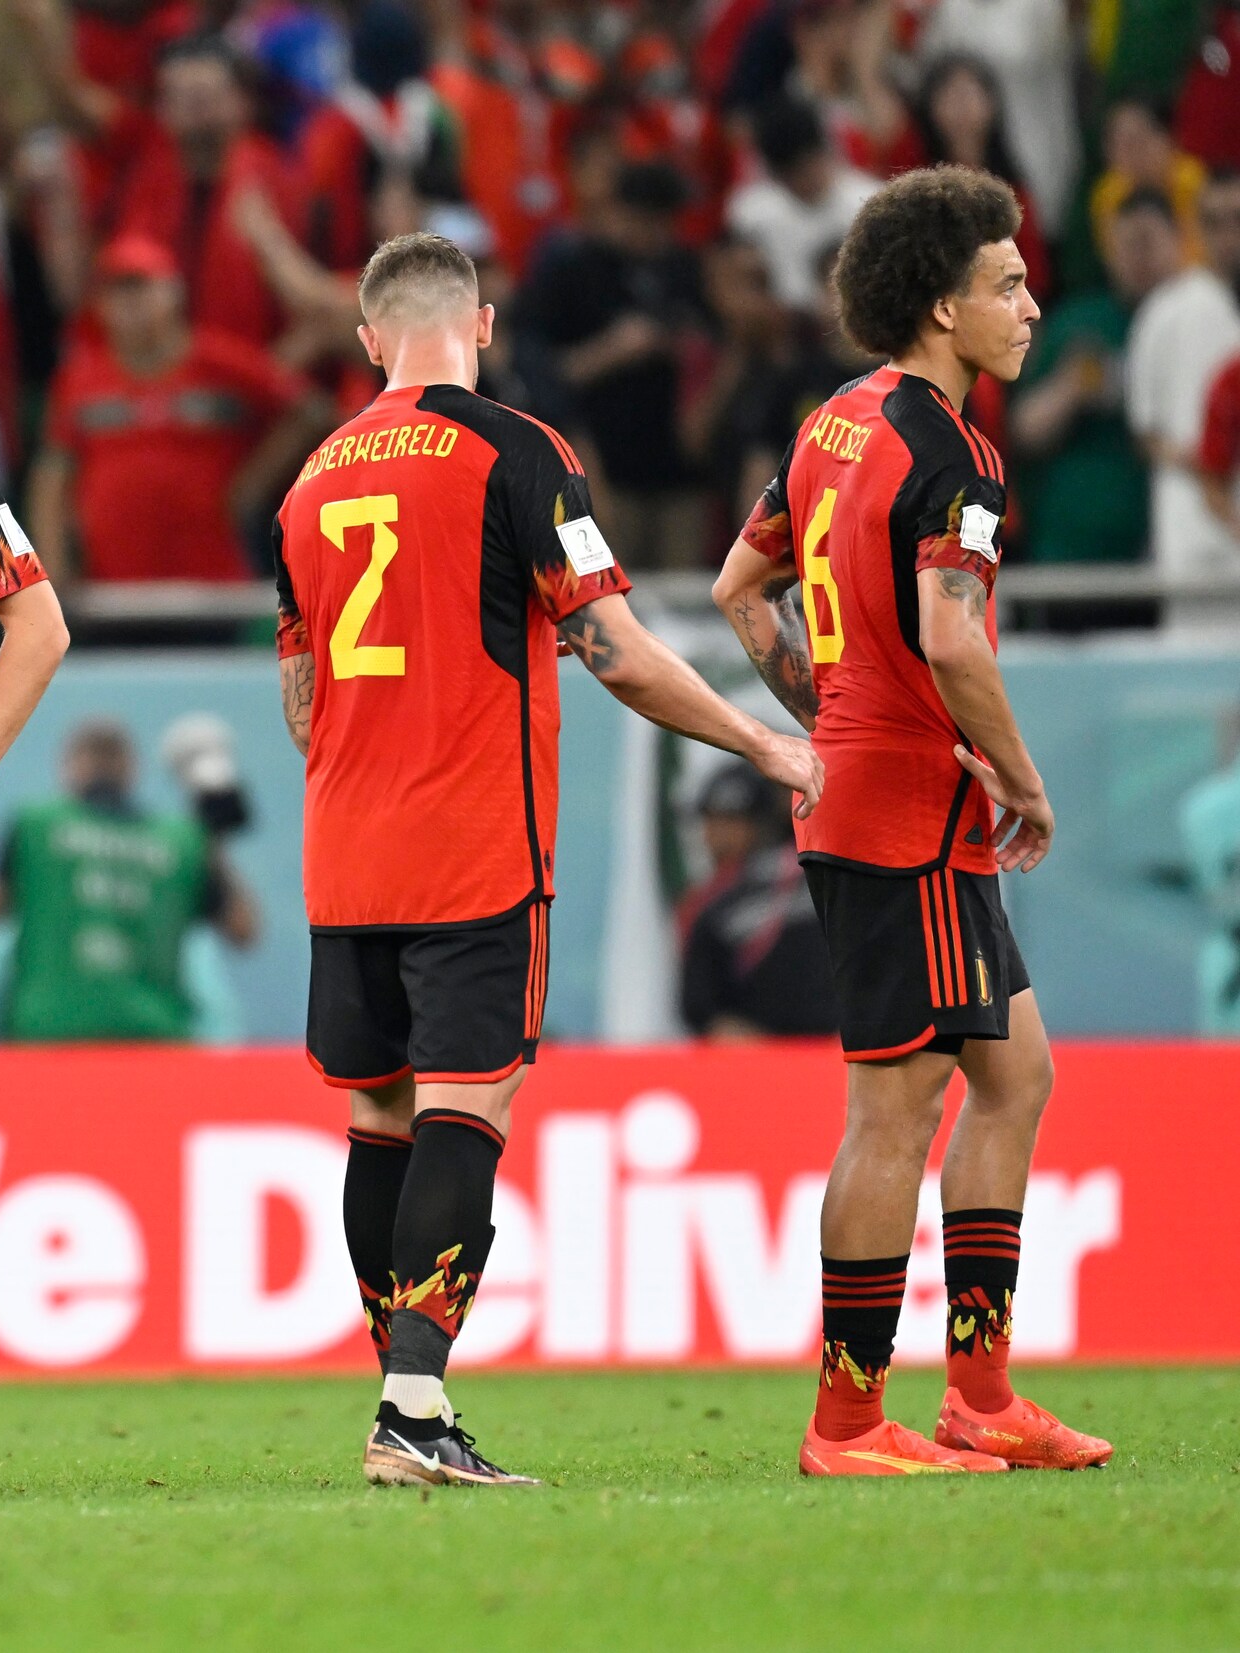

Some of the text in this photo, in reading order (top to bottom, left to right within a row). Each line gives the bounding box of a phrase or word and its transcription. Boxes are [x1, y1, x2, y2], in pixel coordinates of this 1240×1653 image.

[806, 412, 872, 463] WITSEL
[320, 493, 405, 680] 2
[802, 487, 845, 664] 6
[181, 1090, 1122, 1366] Dlivr
[982, 1426, 1024, 1446] ULTRA
